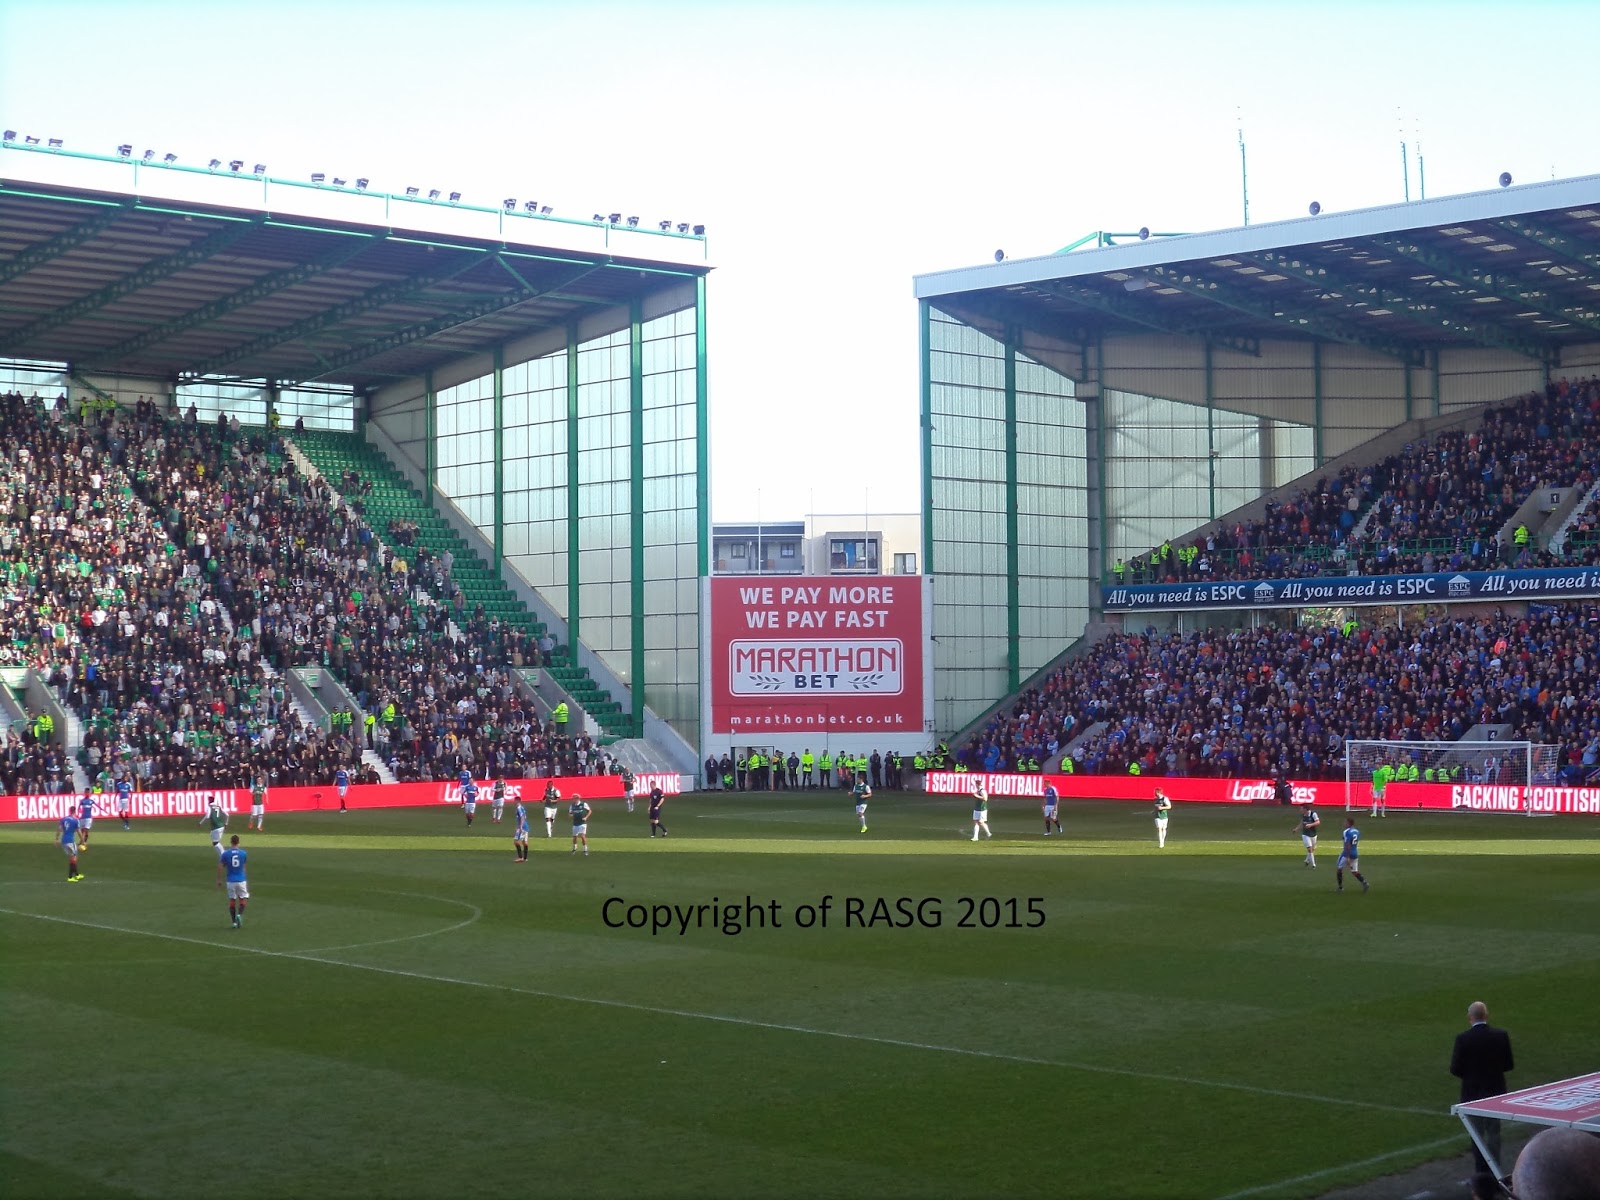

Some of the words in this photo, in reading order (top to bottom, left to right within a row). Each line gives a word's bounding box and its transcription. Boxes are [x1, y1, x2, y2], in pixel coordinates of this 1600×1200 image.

[1280, 583, 1302, 599] All
[1304, 587, 1334, 601] you
[1337, 581, 1375, 597] need
[1379, 580, 1393, 595] is
[1397, 577, 1436, 595] ESPC
[1448, 582, 1471, 590] ESPC
[1480, 575, 1505, 592] All
[1507, 578, 1540, 594] you
[1544, 571, 1587, 589] need
[740, 587, 774, 605] WE
[781, 587, 821, 604] PAY
[829, 586, 894, 604] MORE
[1107, 590, 1127, 604] All
[1128, 593, 1155, 607] you
[1158, 587, 1192, 603] need
[1195, 587, 1208, 602] is
[1211, 585, 1246, 601] ESPC
[745, 611, 780, 628] WE
[787, 610, 827, 628] PAY
[835, 610, 889, 628] FAST
[736, 647, 897, 673] MARATHON
[794, 674, 839, 689] BET
[730, 713, 903, 725] marathonbet.co.uk
[988, 774, 1045, 797] FOOTBALL
[1231, 780, 1318, 803] Ladbkes
[91, 791, 163, 818] SCOTISH
[1452, 785, 1519, 810] BACKING
[1523, 787, 1600, 812] SCOTTISH
[231, 855, 240, 868] 6
